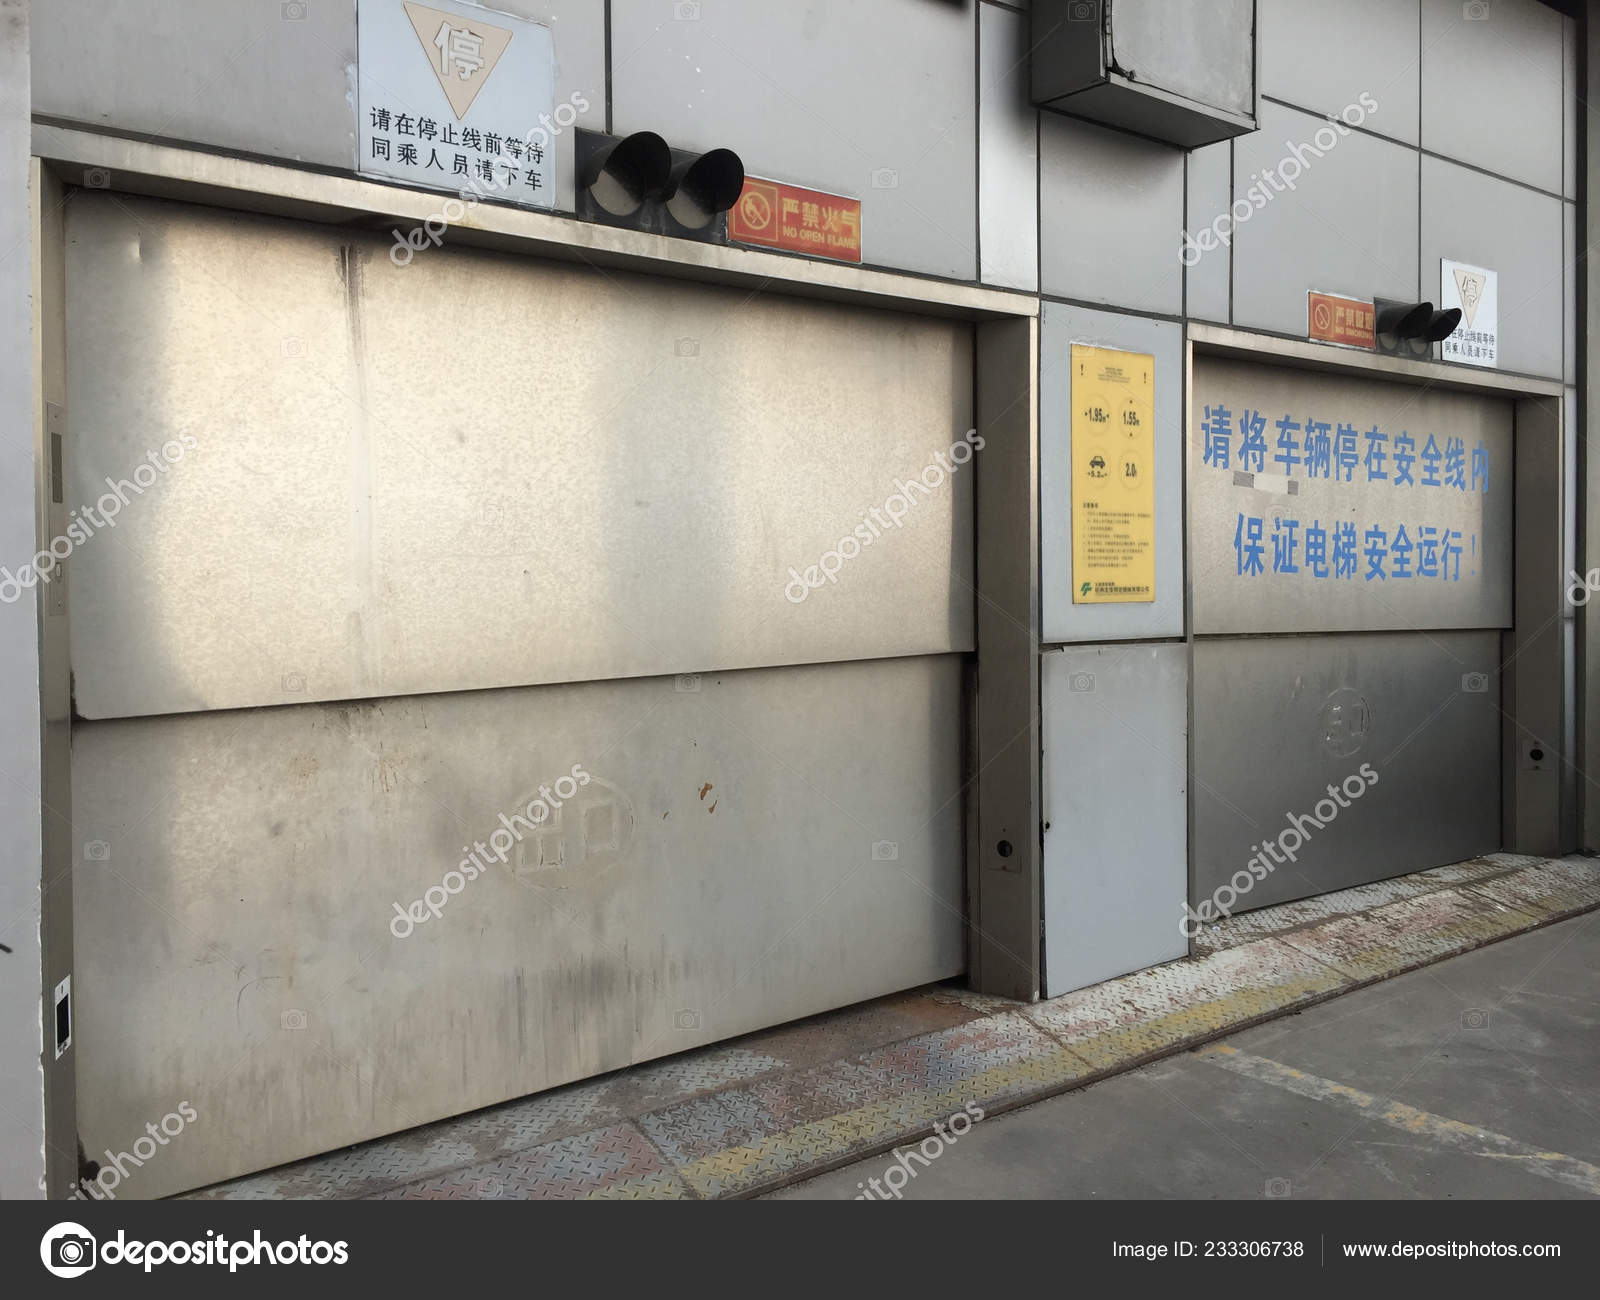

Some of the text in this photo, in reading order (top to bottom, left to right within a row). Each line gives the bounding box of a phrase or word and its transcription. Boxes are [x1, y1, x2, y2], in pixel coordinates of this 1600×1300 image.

[433, 20, 485, 82] 停
[370, 106, 545, 165] 请在停止线前等待
[371, 136, 543, 191] 同乘人员请下车
[783, 226, 798, 238] NO
[800, 229, 825, 244] OPEN
[1201, 404, 1490, 493] 请将车辆停在安全线内
[1234, 512, 1476, 582] 保证电梯安全运行！
